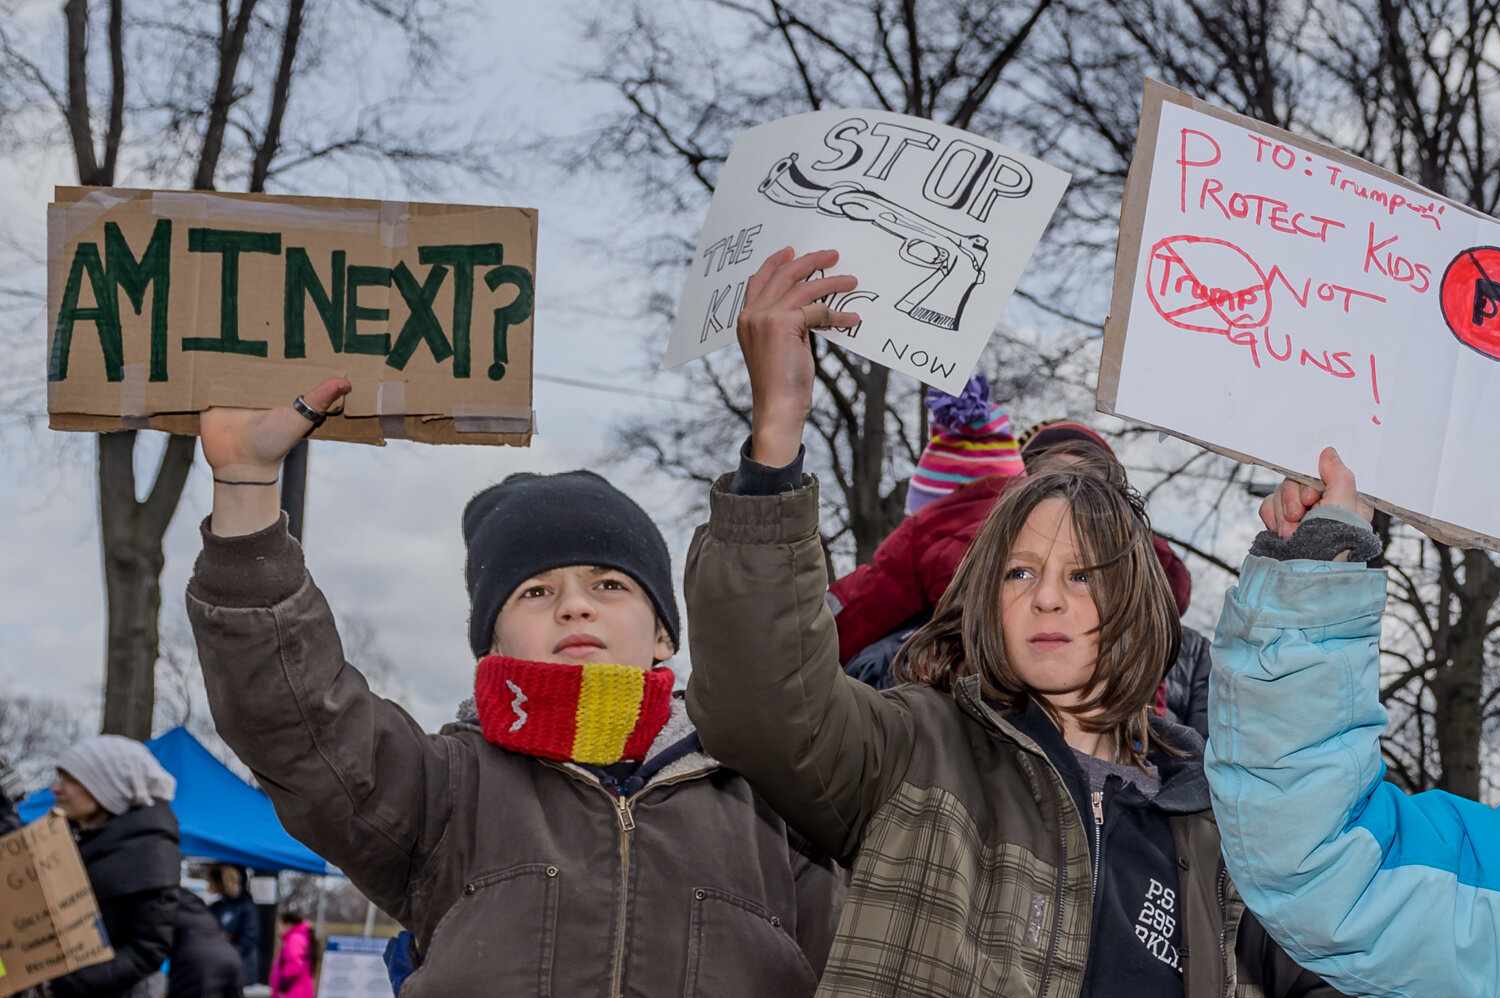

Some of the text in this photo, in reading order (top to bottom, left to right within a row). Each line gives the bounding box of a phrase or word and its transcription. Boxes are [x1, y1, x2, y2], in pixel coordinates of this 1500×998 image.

[812, 118, 1033, 223] STOP
[1176, 128, 1433, 293] PROTECT KIDS
[703, 224, 763, 278] THE
[48, 219, 533, 382] AM I NEXT?
[1265, 264, 1387, 313] NOT
[882, 338, 957, 379] NOW
[1138, 901, 1176, 938] 295
[1145, 878, 1176, 913] P.S.
